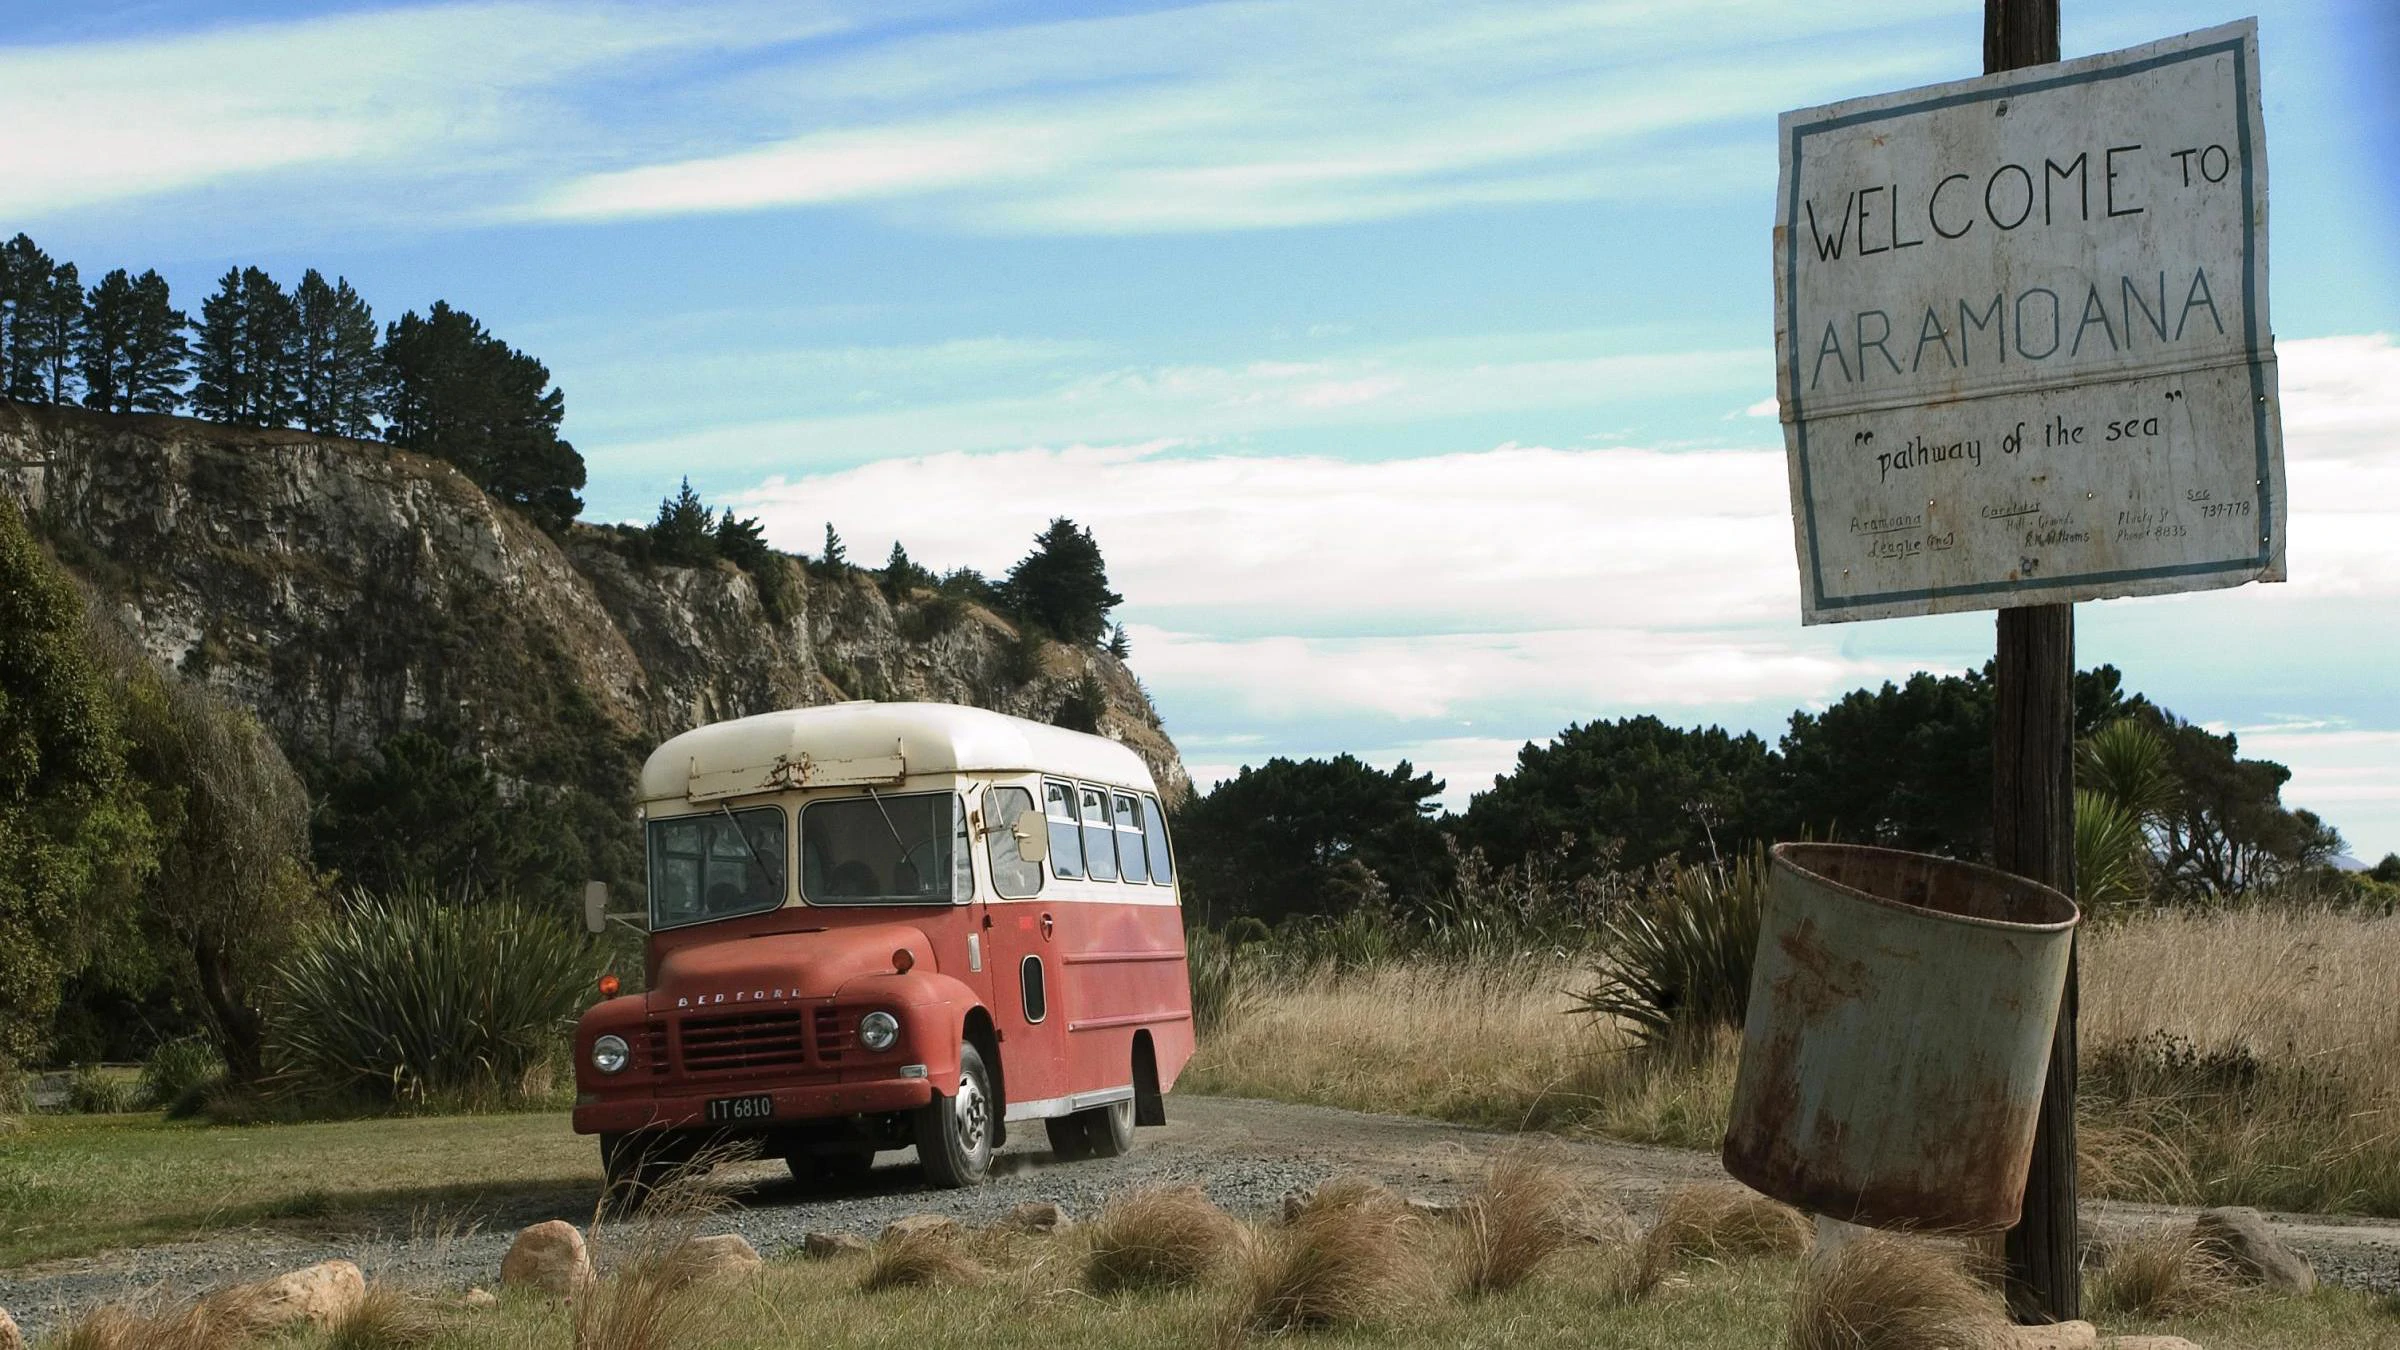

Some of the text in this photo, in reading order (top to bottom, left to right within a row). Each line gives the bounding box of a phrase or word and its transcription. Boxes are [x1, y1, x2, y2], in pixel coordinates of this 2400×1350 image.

[1806, 144, 2230, 262] WELCOME TO
[1811, 266, 2225, 390] ARAMOANA
[2002, 421, 2025, 453] of
[2046, 415, 2084, 447] the
[1850, 514, 1922, 536] Aramoana
[1867, 540, 1921, 559] League
